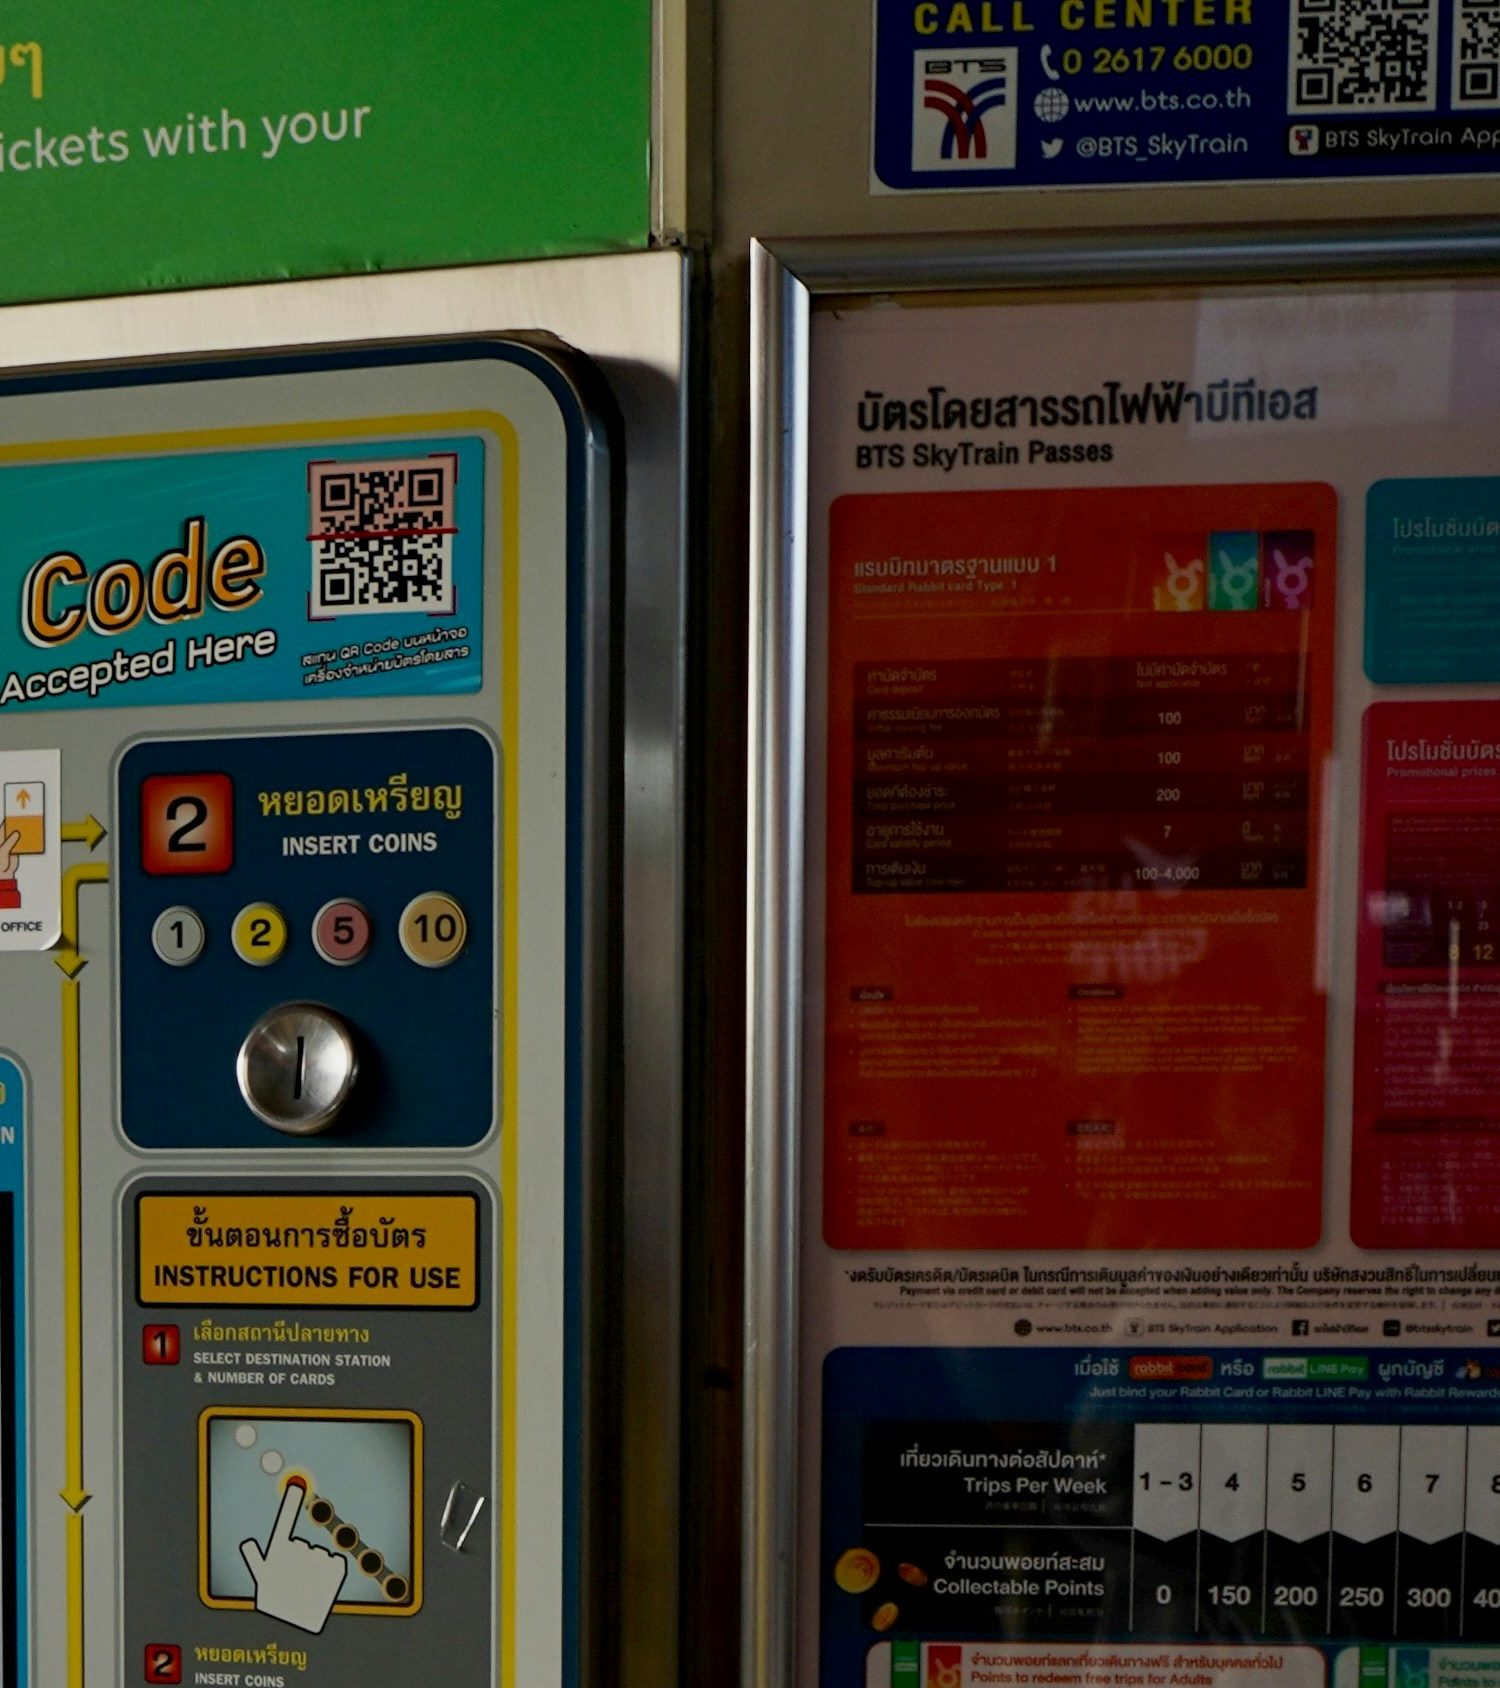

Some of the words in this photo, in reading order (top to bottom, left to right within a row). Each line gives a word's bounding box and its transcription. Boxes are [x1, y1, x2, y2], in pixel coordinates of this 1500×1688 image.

[914, 1, 1034, 34] CALL
[1061, 0, 1253, 30] CENTER
[925, 59, 1006, 74] BTS
[1062, 48, 1081, 75] 0
[1095, 46, 1164, 73] 2617
[1174, 44, 1252, 70] 6000
[1074, 88, 1251, 114] www.bts.co.th
[144, 110, 247, 156] with
[262, 105, 372, 158] your
[1324, 128, 1360, 149] BTS
[1365, 126, 1453, 152] SkyTrain
[1076, 132, 1248, 161] @BTS_SkyTrain
[856, 380, 1317, 433] บัตรโดยสารรถไฟฟ้าบีทีเอส
[856, 444, 905, 469] BTS
[912, 441, 1020, 470] SkyTrain
[1028, 439, 1113, 466] Passes
[341, 647, 359, 660] QR
[364, 639, 399, 655] Code
[0, 640, 177, 708] Accepted
[187, 627, 277, 676] Here
[258, 773, 463, 820] หยอดเหรียญ
[166, 796, 208, 853] 2
[282, 834, 361, 856] INSERT
[368, 832, 438, 853] COINS
[0, 921, 43, 933] OFFICE
[170, 921, 183, 948] 1
[250, 919, 271, 946] 2
[333, 917, 354, 944] 5
[414, 914, 456, 942] 10
[187, 1205, 427, 1250] ขั้นตอนการซื้อบัตร
[154, 1265, 338, 1288] INSTRUCTIONS
[348, 1266, 398, 1288] FOR
[411, 1267, 461, 1289] USE
[193, 1320, 369, 1344] เลือกสถานีปลายทาง
[964, 1477, 1011, 1497] Trips
[1016, 1477, 1048, 1495] Per
[1053, 1476, 1107, 1495] Week
[1224, 1473, 1240, 1491] 4
[1291, 1473, 1306, 1492] 5
[1357, 1474, 1372, 1493] 6
[1425, 1474, 1440, 1493] 7
[944, 1549, 1105, 1573] จำนวนพอยท์สะสม
[933, 1578, 1040, 1597] Collectable
[1044, 1580, 1105, 1597] Points
[1156, 1586, 1171, 1606] 0
[1208, 1586, 1251, 1606] 150
[1274, 1586, 1318, 1607] 200
[1340, 1588, 1384, 1607] 250
[1407, 1589, 1451, 1608] 300
[194, 1644, 308, 1670] หยอดเหรียญ
[194, 1672, 240, 1687] INSERT
[244, 1674, 284, 1688] COINS
